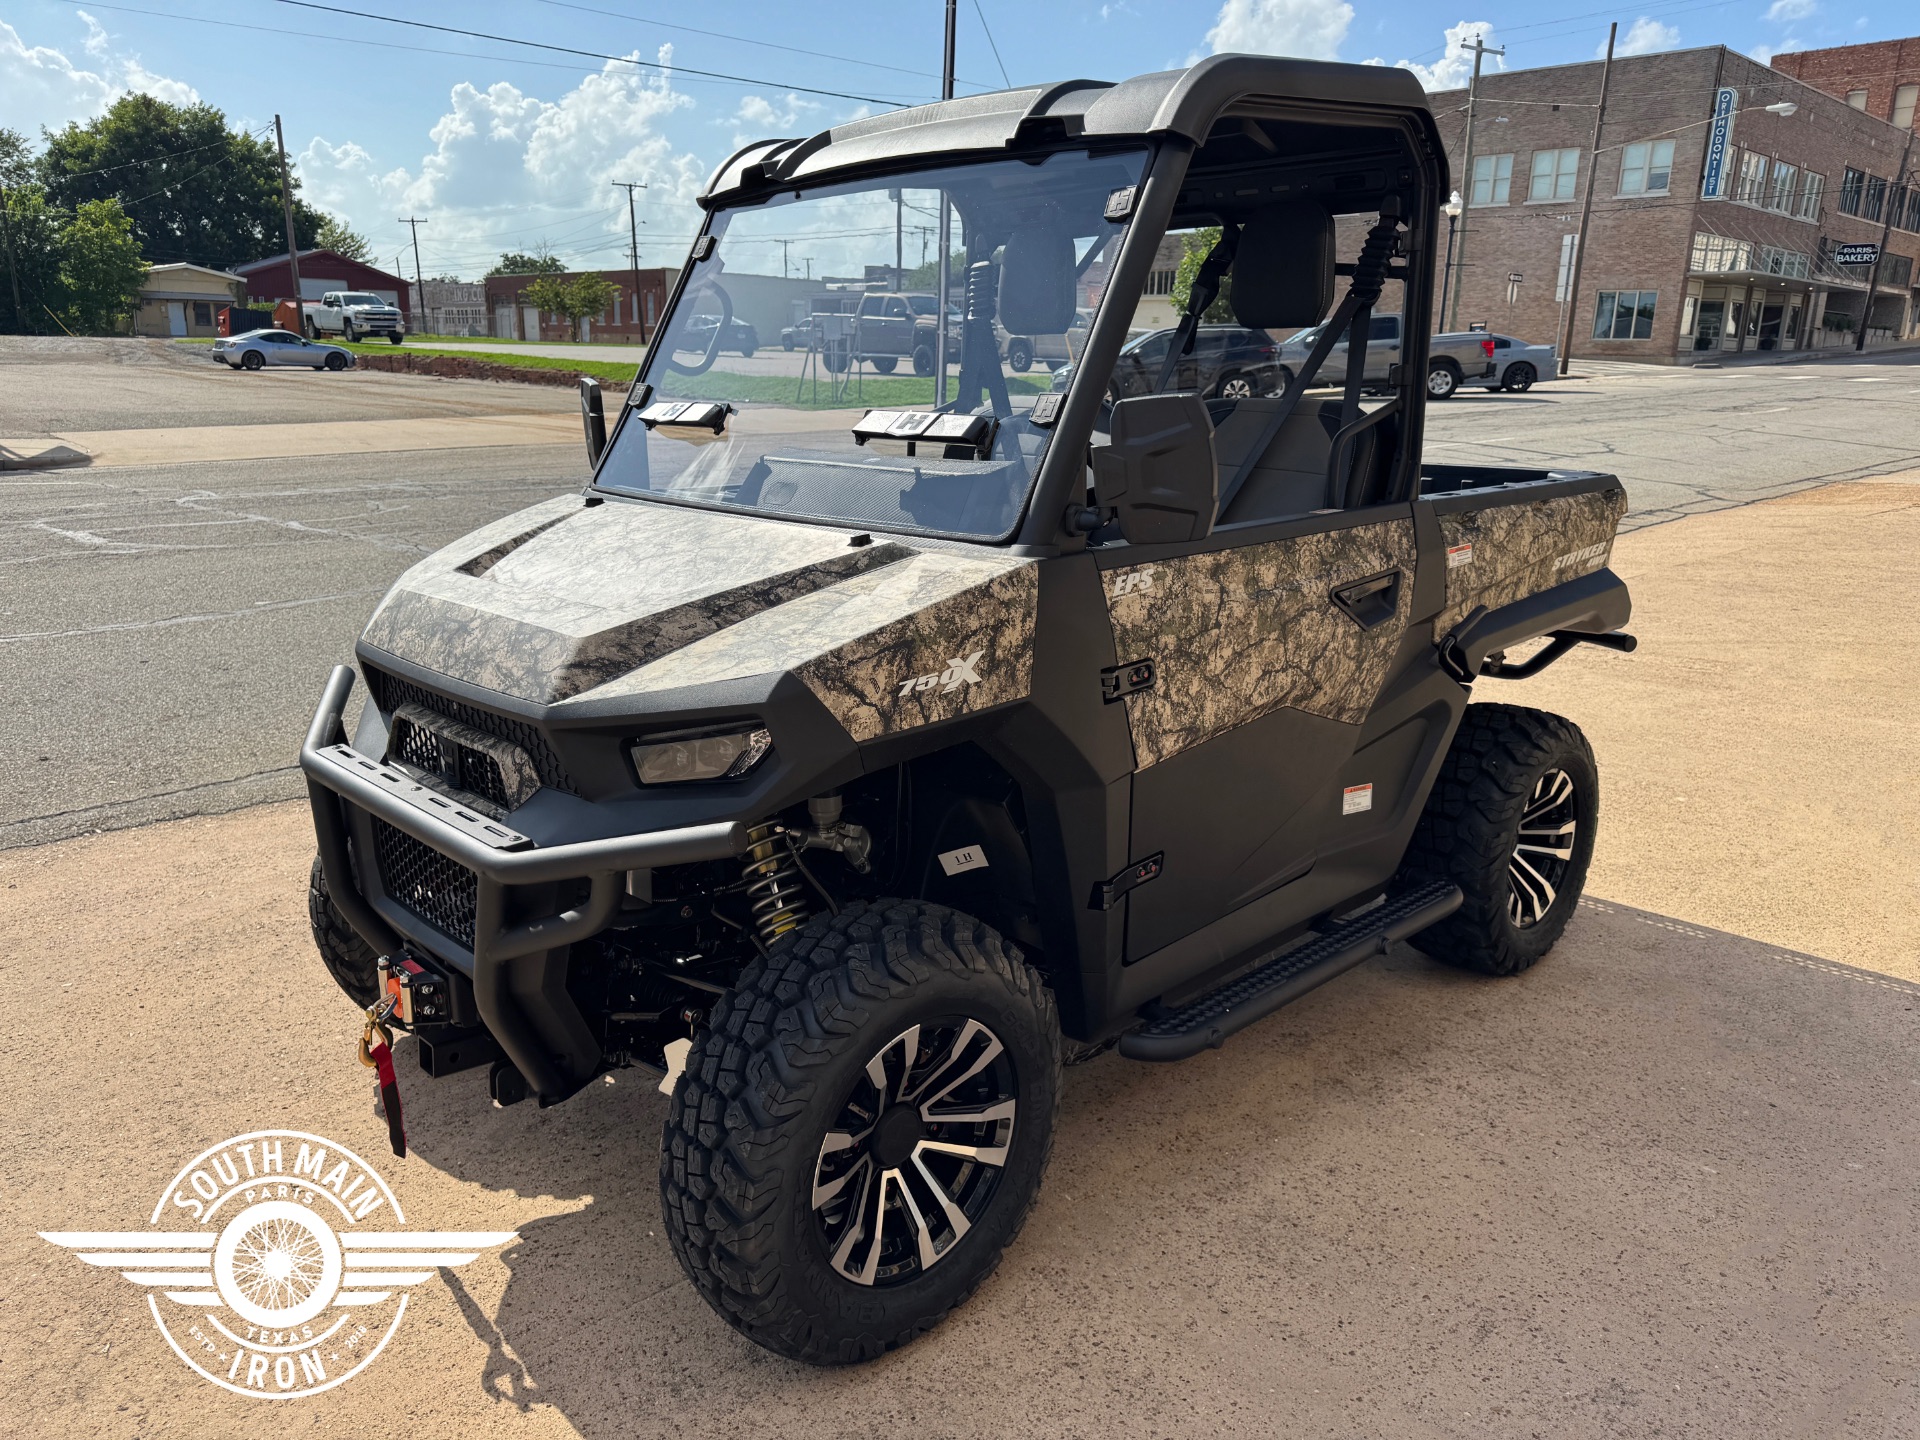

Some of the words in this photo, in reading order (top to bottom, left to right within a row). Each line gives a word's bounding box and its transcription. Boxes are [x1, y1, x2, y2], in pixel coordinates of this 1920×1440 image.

[1708, 93, 1730, 194] ORTHODONTIST
[1836, 253, 1877, 262] BAKERY
[1843, 246, 1873, 254] PARIS
[1551, 541, 1607, 571] STRYKER
[1113, 568, 1154, 598] EPS
[898, 649, 986, 697] 750X
